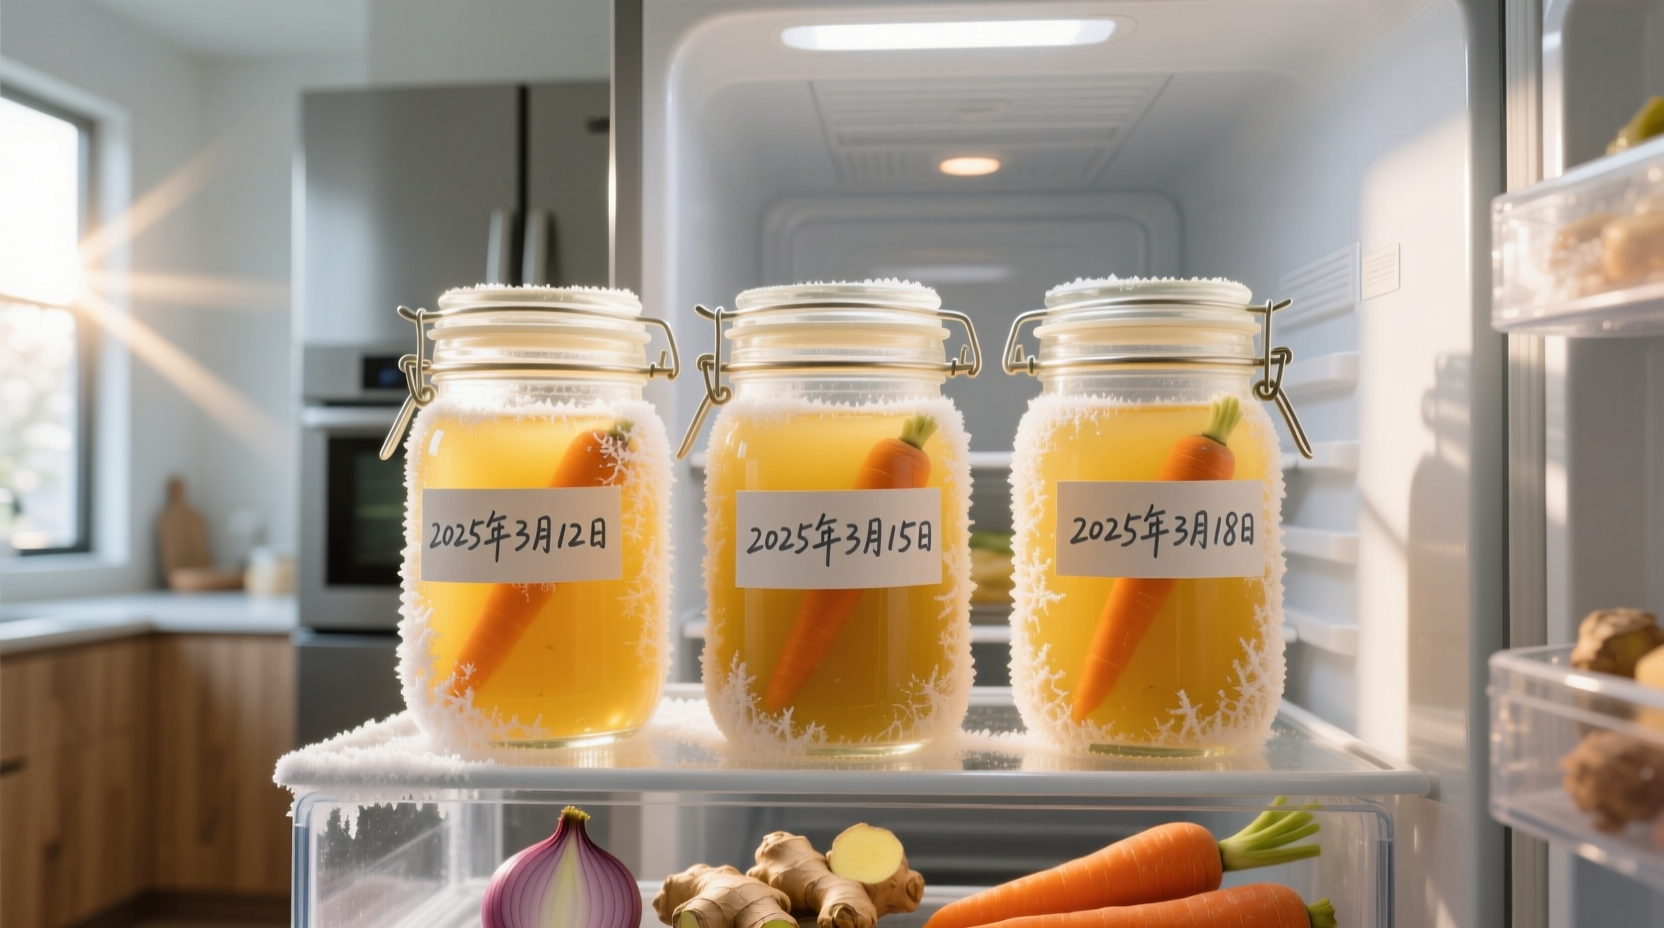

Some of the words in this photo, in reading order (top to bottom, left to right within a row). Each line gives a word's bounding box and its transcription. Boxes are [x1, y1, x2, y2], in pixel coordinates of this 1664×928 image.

[429, 510, 606, 563] 2025年3月12日
[747, 512, 932, 567] 2025年3月15日
[1069, 504, 1253, 558] 2025年3月18日
